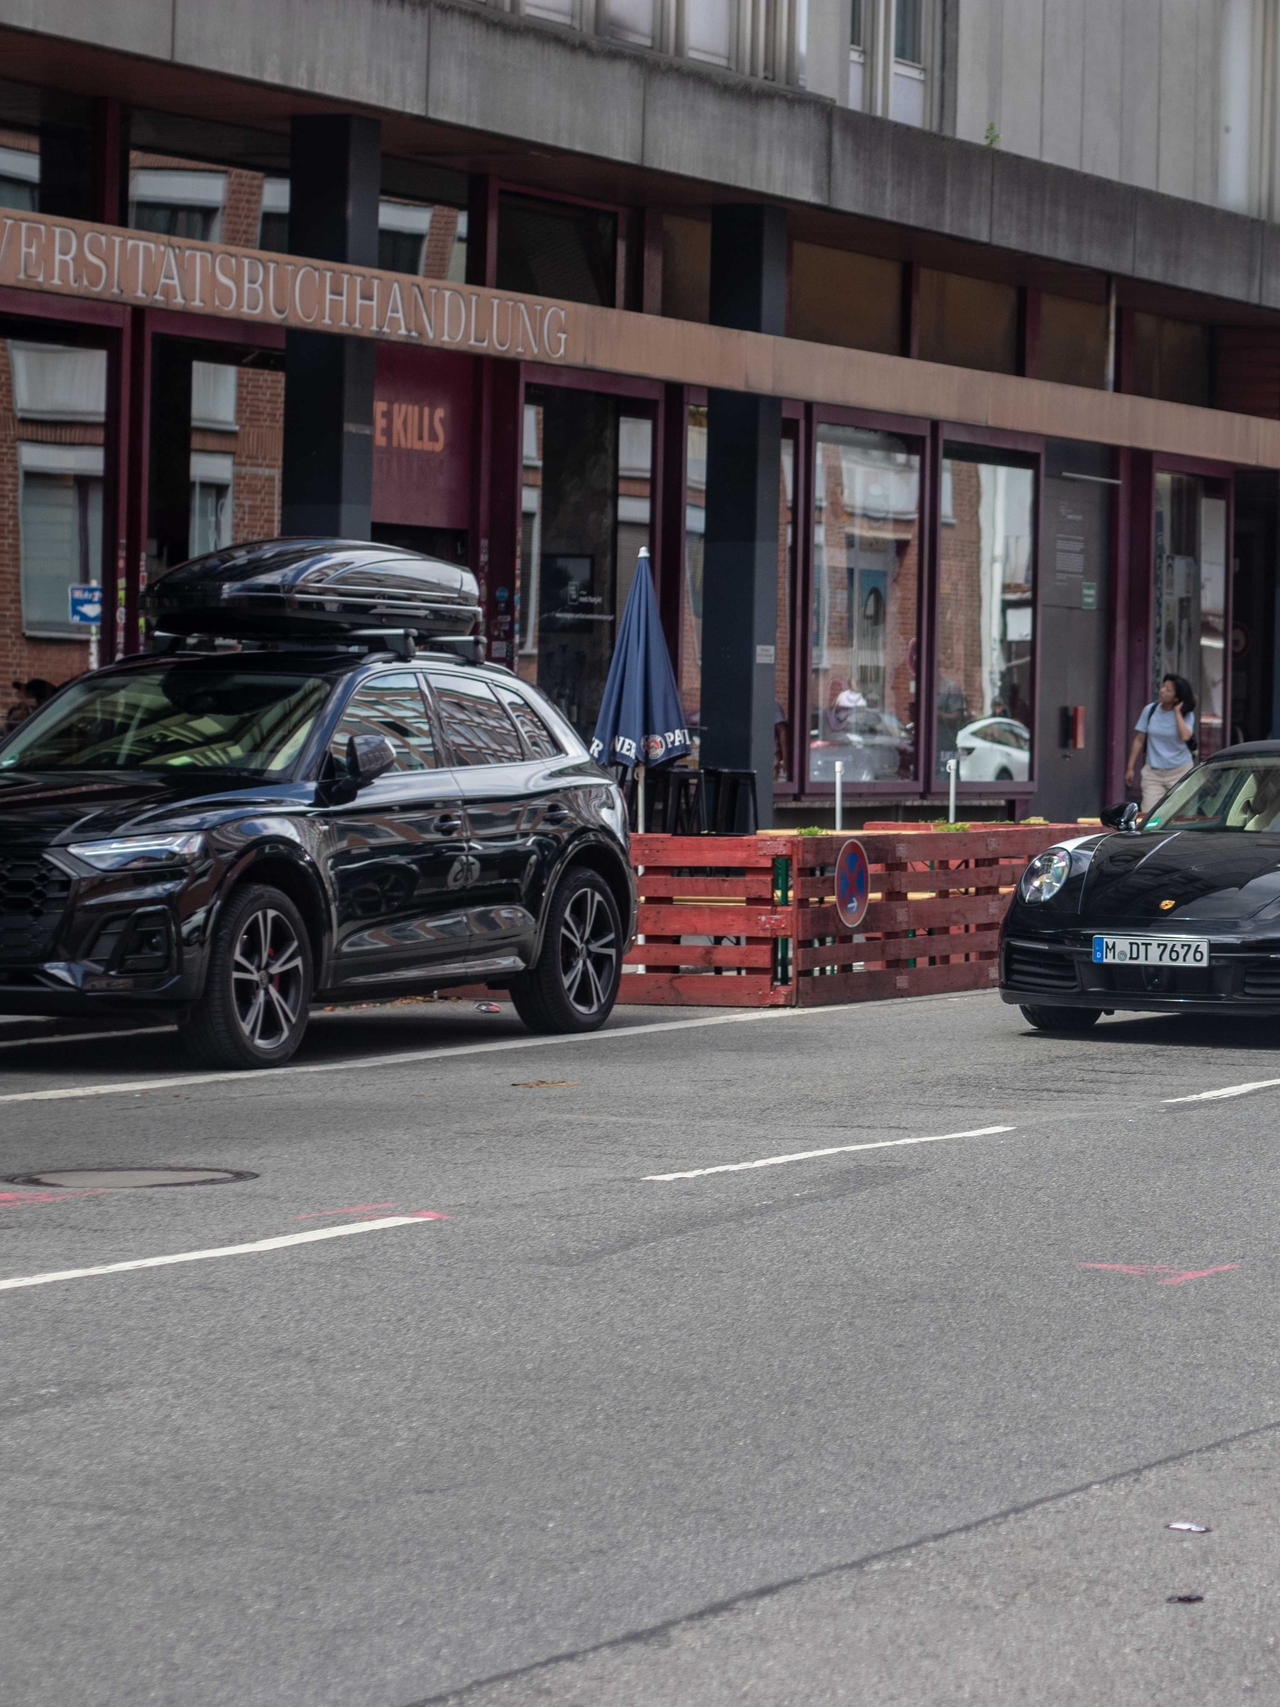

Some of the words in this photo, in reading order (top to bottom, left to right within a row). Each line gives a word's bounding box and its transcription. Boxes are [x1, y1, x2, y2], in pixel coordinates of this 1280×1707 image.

[391, 402, 446, 453] KILLS
[1104, 940, 1116, 960] M
[1128, 941, 1152, 962] DT
[1156, 943, 1204, 963] 7676
